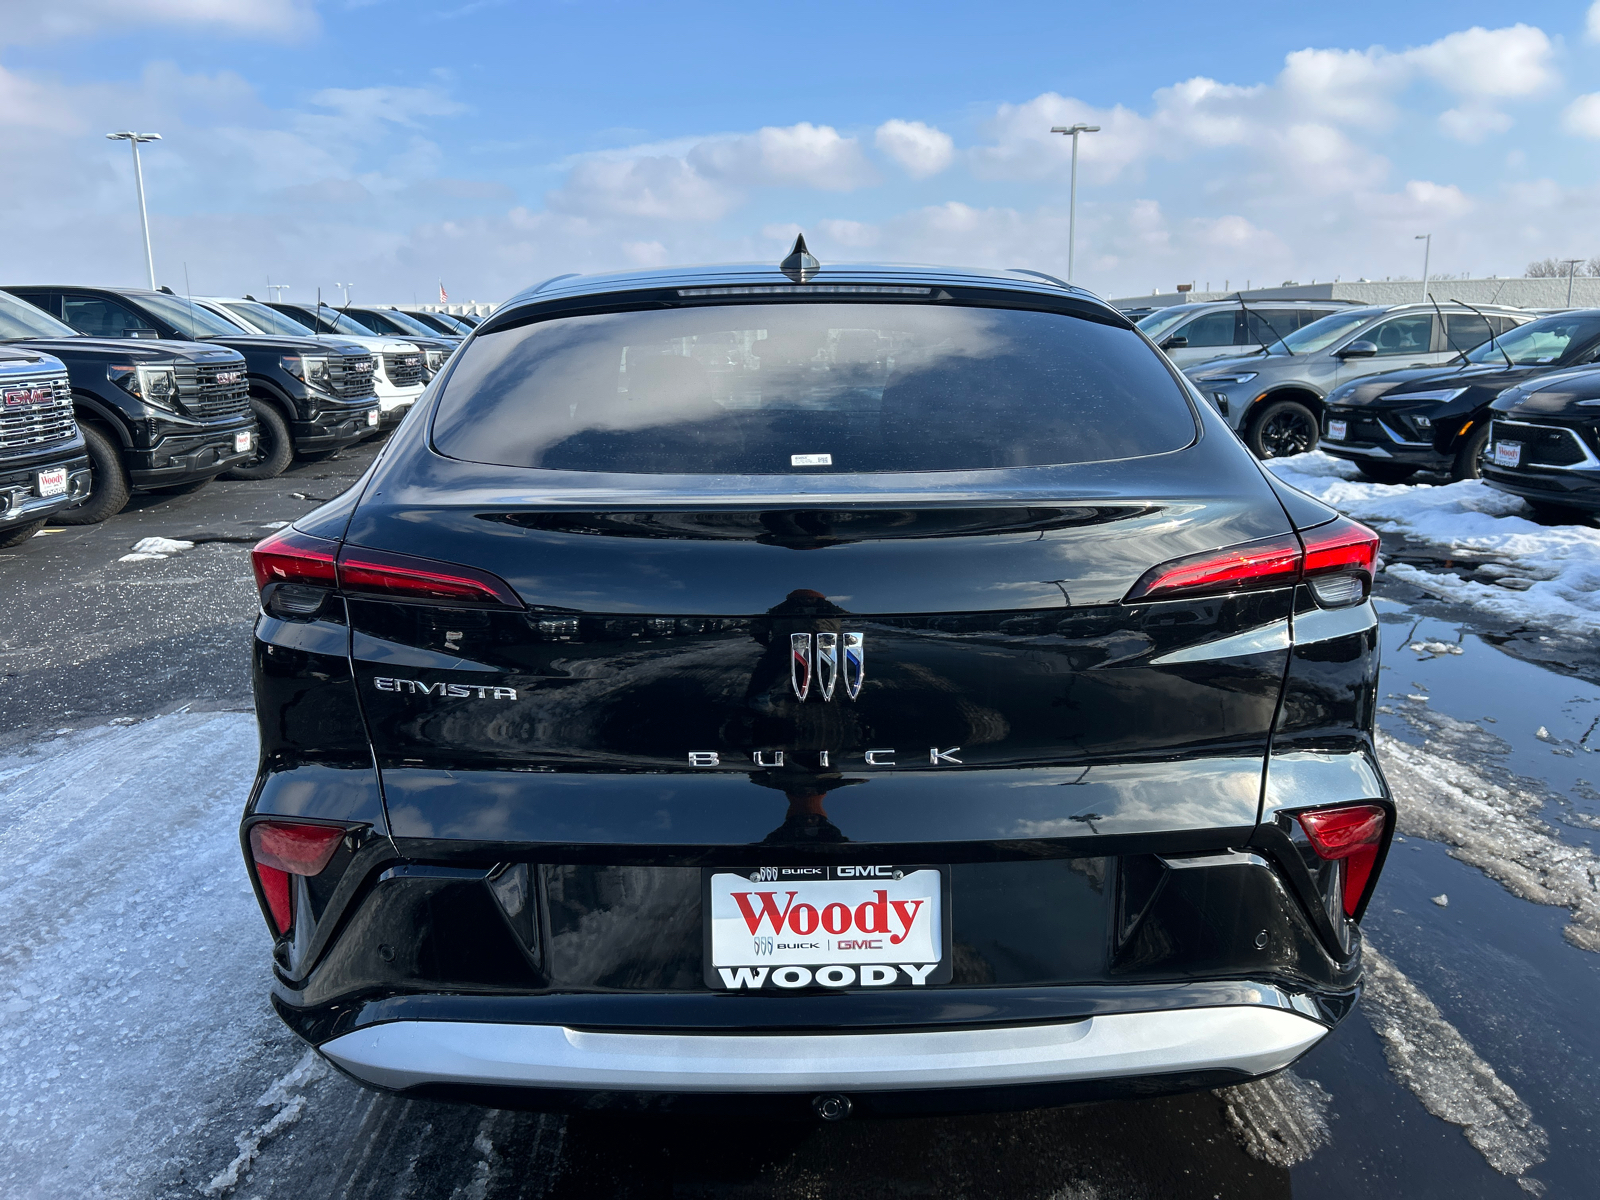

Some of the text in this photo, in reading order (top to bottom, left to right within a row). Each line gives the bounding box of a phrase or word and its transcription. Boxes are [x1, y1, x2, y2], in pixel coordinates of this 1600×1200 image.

[5, 389, 53, 405] GMC
[1498, 446, 1518, 458] Woody
[41, 474, 64, 485] Woody
[373, 676, 518, 700] ENVISTA
[688, 747, 963, 767] BUICK
[837, 865, 893, 877] GMC
[730, 890, 924, 945] Woody
[837, 939, 883, 950] GMC
[718, 964, 938, 989] WOODY
